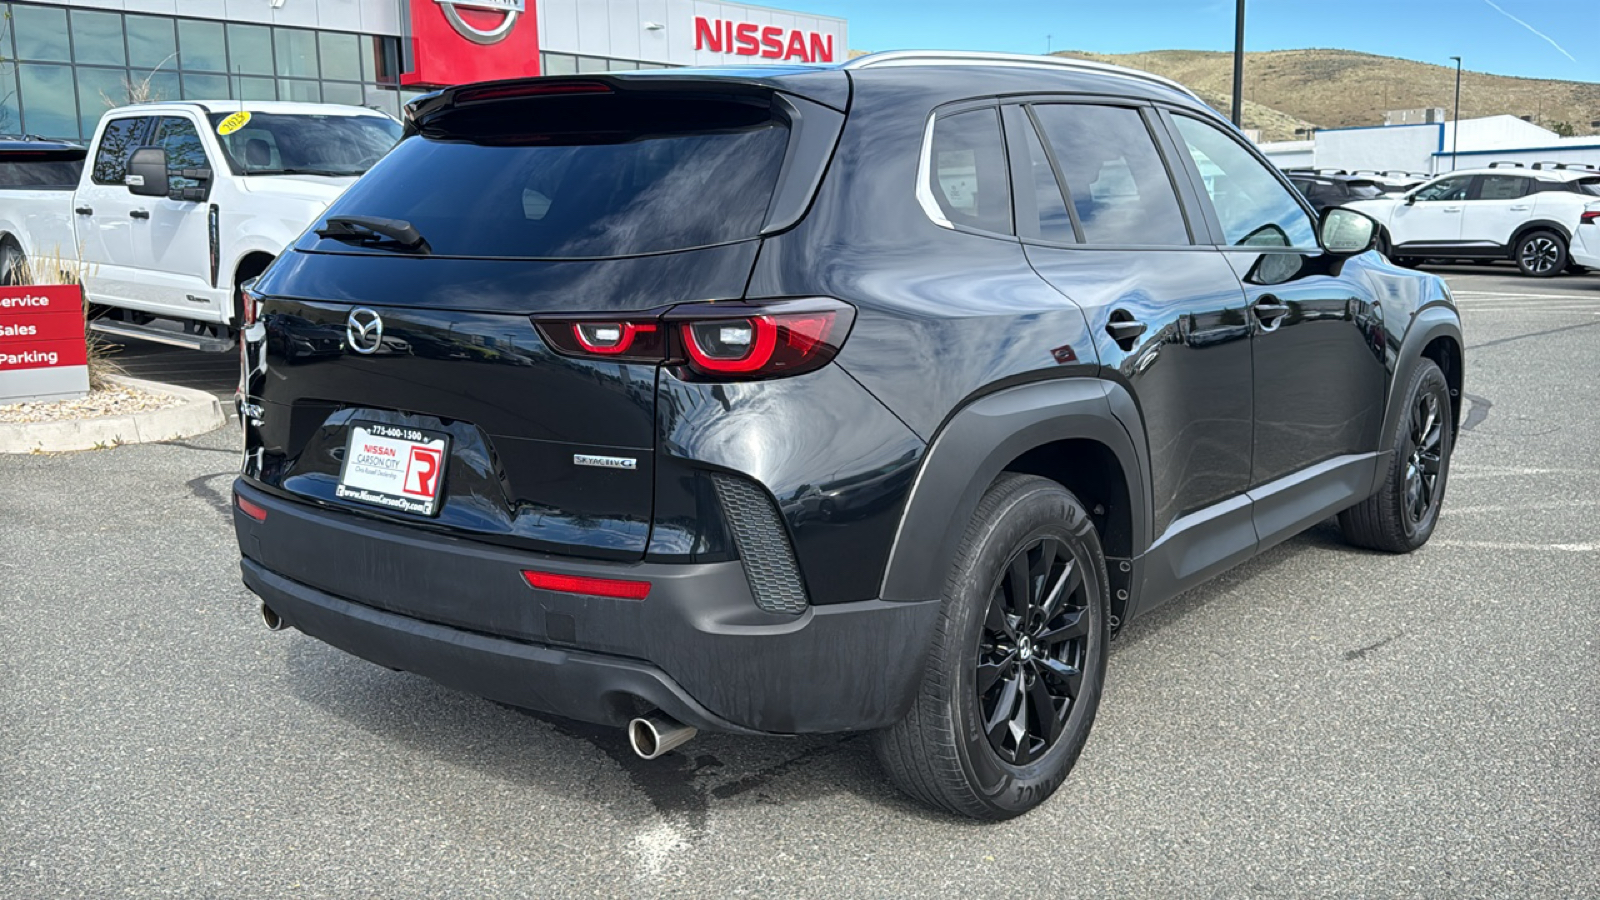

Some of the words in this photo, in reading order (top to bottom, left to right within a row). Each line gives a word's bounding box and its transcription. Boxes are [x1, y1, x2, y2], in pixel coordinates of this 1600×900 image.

[695, 16, 833, 63] NISSAN
[0, 294, 50, 308] ervice
[0, 350, 58, 365] Parking
[373, 425, 422, 440] 775-600-1500
[364, 444, 396, 457] NISSAN
[357, 453, 385, 466] CARSON
[385, 458, 401, 470] CITY
